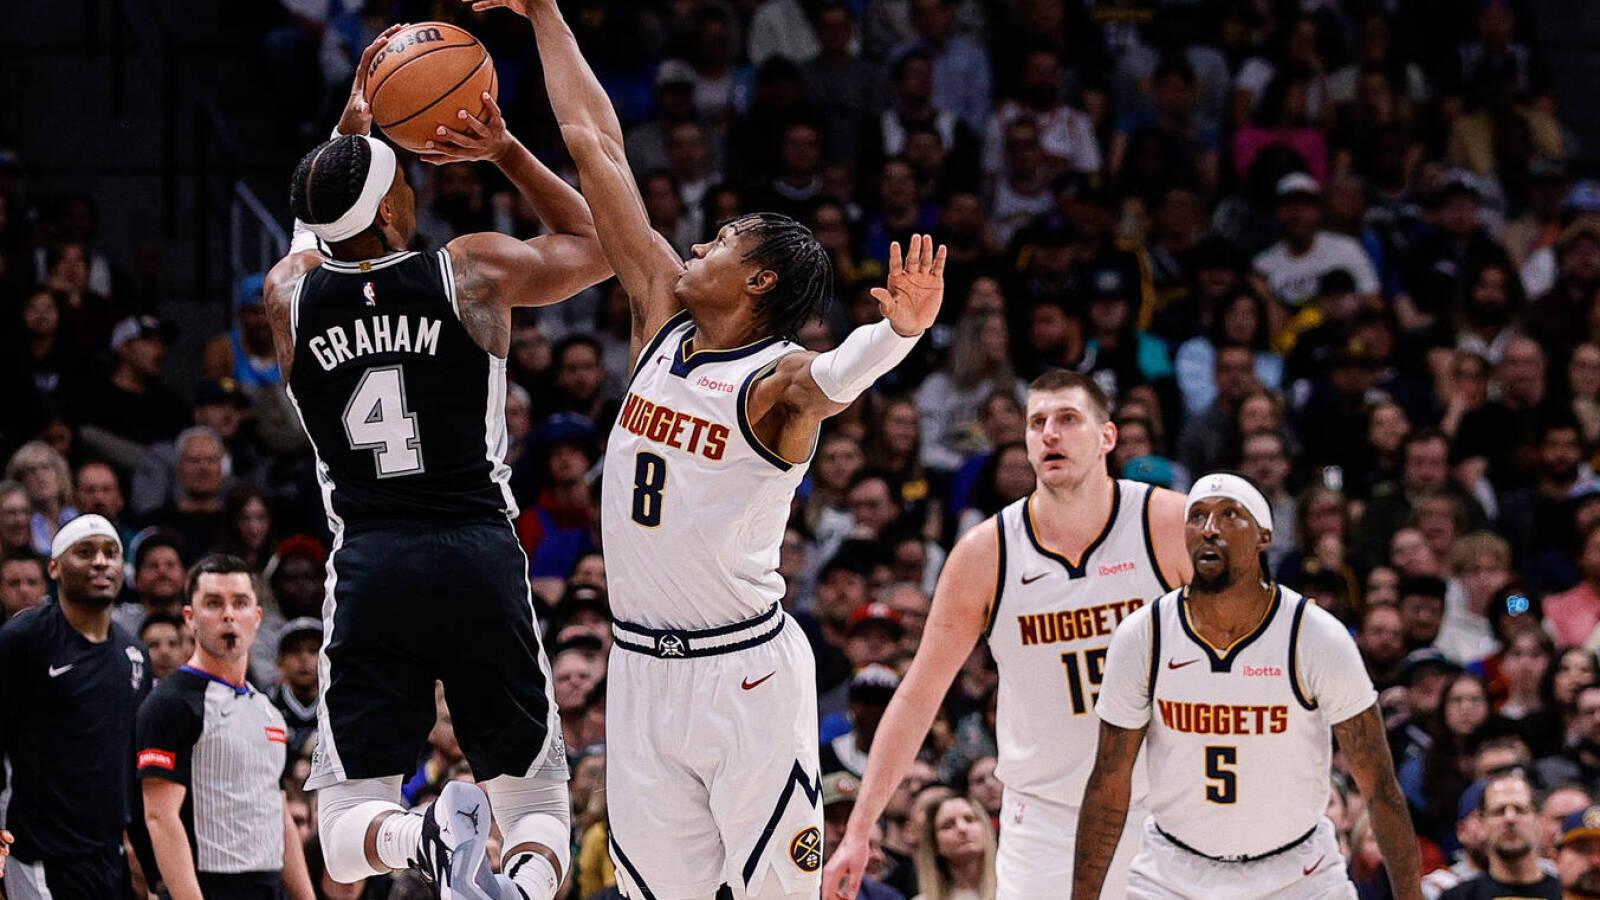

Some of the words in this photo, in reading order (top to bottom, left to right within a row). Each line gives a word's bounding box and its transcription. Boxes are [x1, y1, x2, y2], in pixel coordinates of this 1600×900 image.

[309, 315, 442, 371] GRAHAM
[697, 375, 734, 393] ibotta
[341, 364, 425, 479] 4
[619, 391, 732, 461] NUGGETS
[631, 450, 667, 529] 8
[1098, 561, 1135, 576] ibotta
[1243, 665, 1282, 677] ibotta
[1157, 698, 1288, 735] NUGGETS
[1205, 745, 1237, 806] 5
